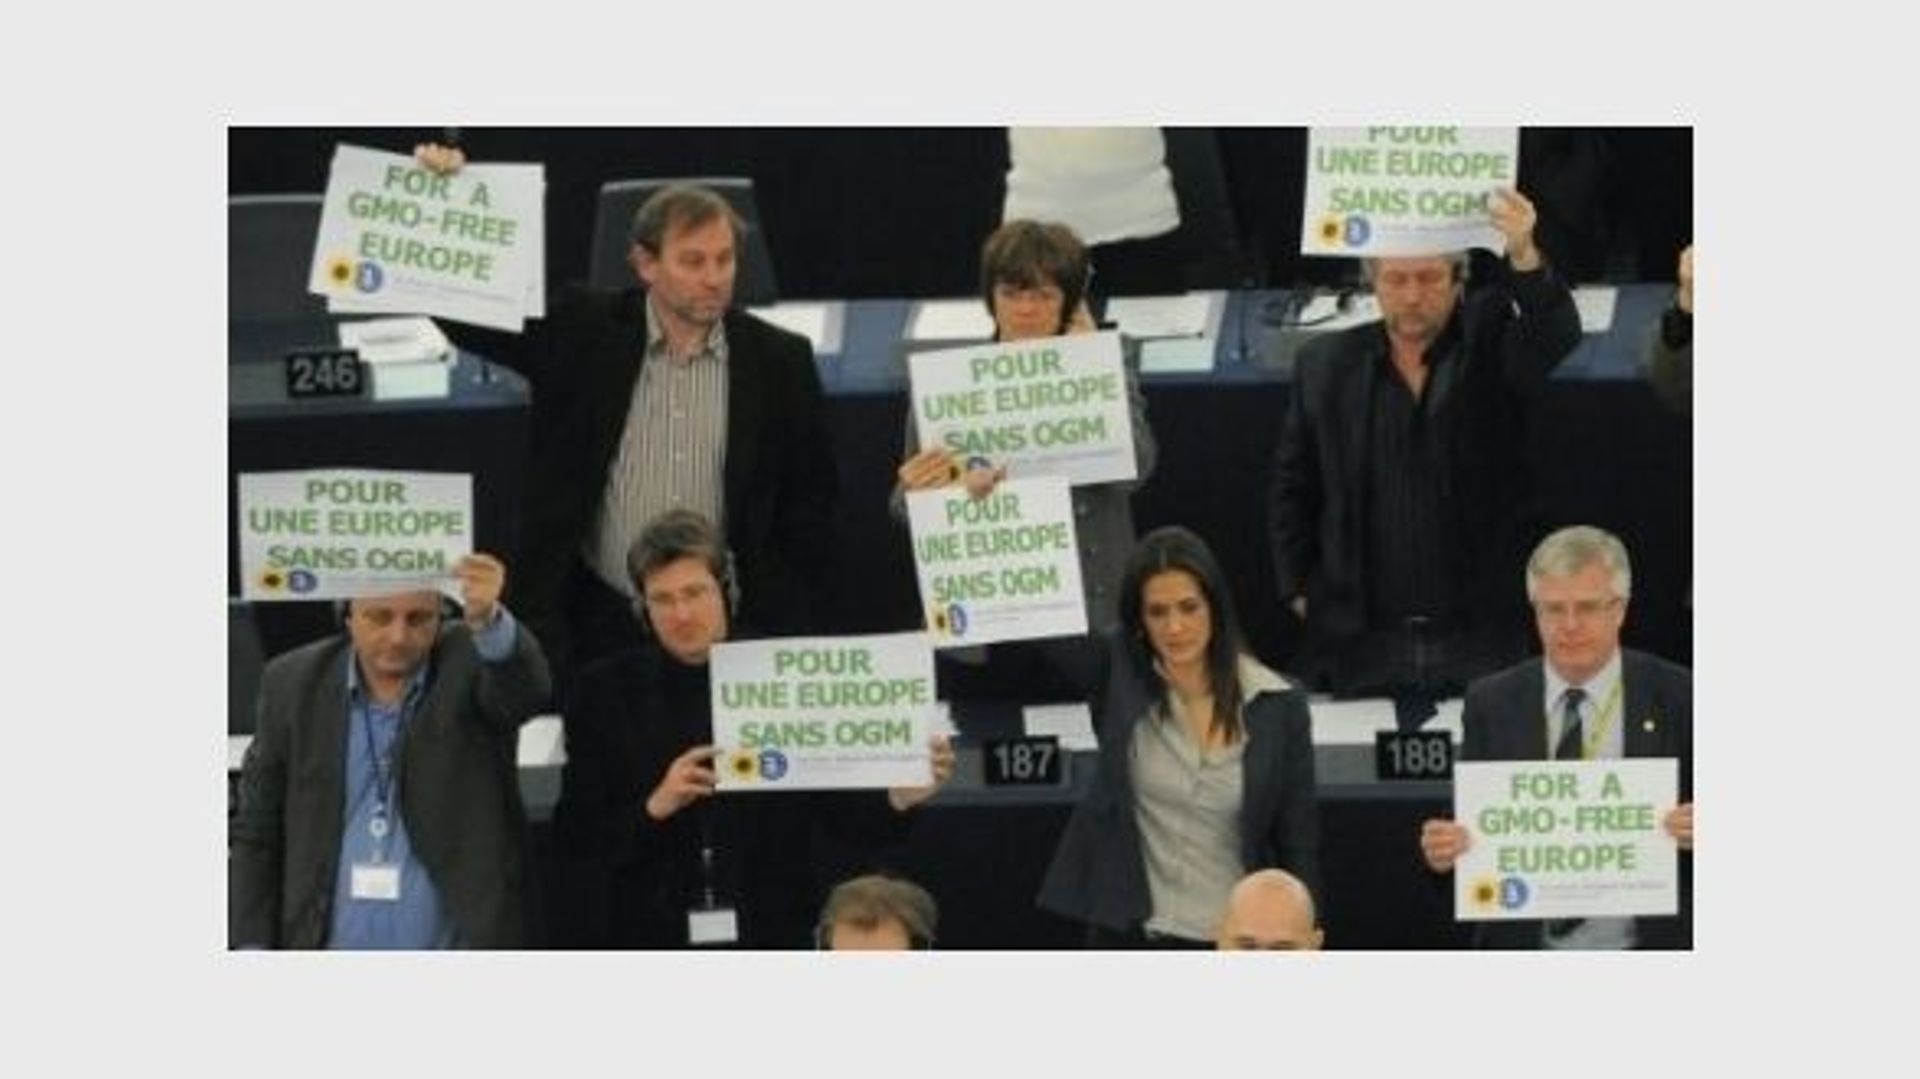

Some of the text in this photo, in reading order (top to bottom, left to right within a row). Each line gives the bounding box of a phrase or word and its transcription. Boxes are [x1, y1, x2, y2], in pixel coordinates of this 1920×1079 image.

[1317, 147, 1508, 180] UNE EUROPE
[385, 165, 490, 206] FOR A
[1329, 187, 1409, 214] SANS
[348, 191, 517, 247] GMO-FREE
[360, 230, 496, 282] EUROPE
[291, 356, 358, 392] 246
[970, 350, 1063, 382] POUR
[923, 373, 1119, 421] UNE EUROPE
[944, 416, 1107, 454] SANS OGM
[306, 480, 406, 504] POUR
[249, 508, 465, 537] UNE EUROPE
[946, 494, 1020, 526] POUR
[267, 546, 445, 572] SANS OGM
[917, 522, 1069, 565] UNE EUROPE
[932, 565, 1061, 602] SANS OGM
[775, 649, 873, 677] POUR
[721, 678, 929, 709] UNE EUROPE
[738, 719, 912, 748] SANS OGM
[993, 743, 1053, 779] 187
[1387, 738, 1449, 775] 188
[1511, 772, 1624, 801] FOR A
[1477, 804, 1656, 836] GMO-FREE
[1498, 843, 1638, 873] EUROPE
